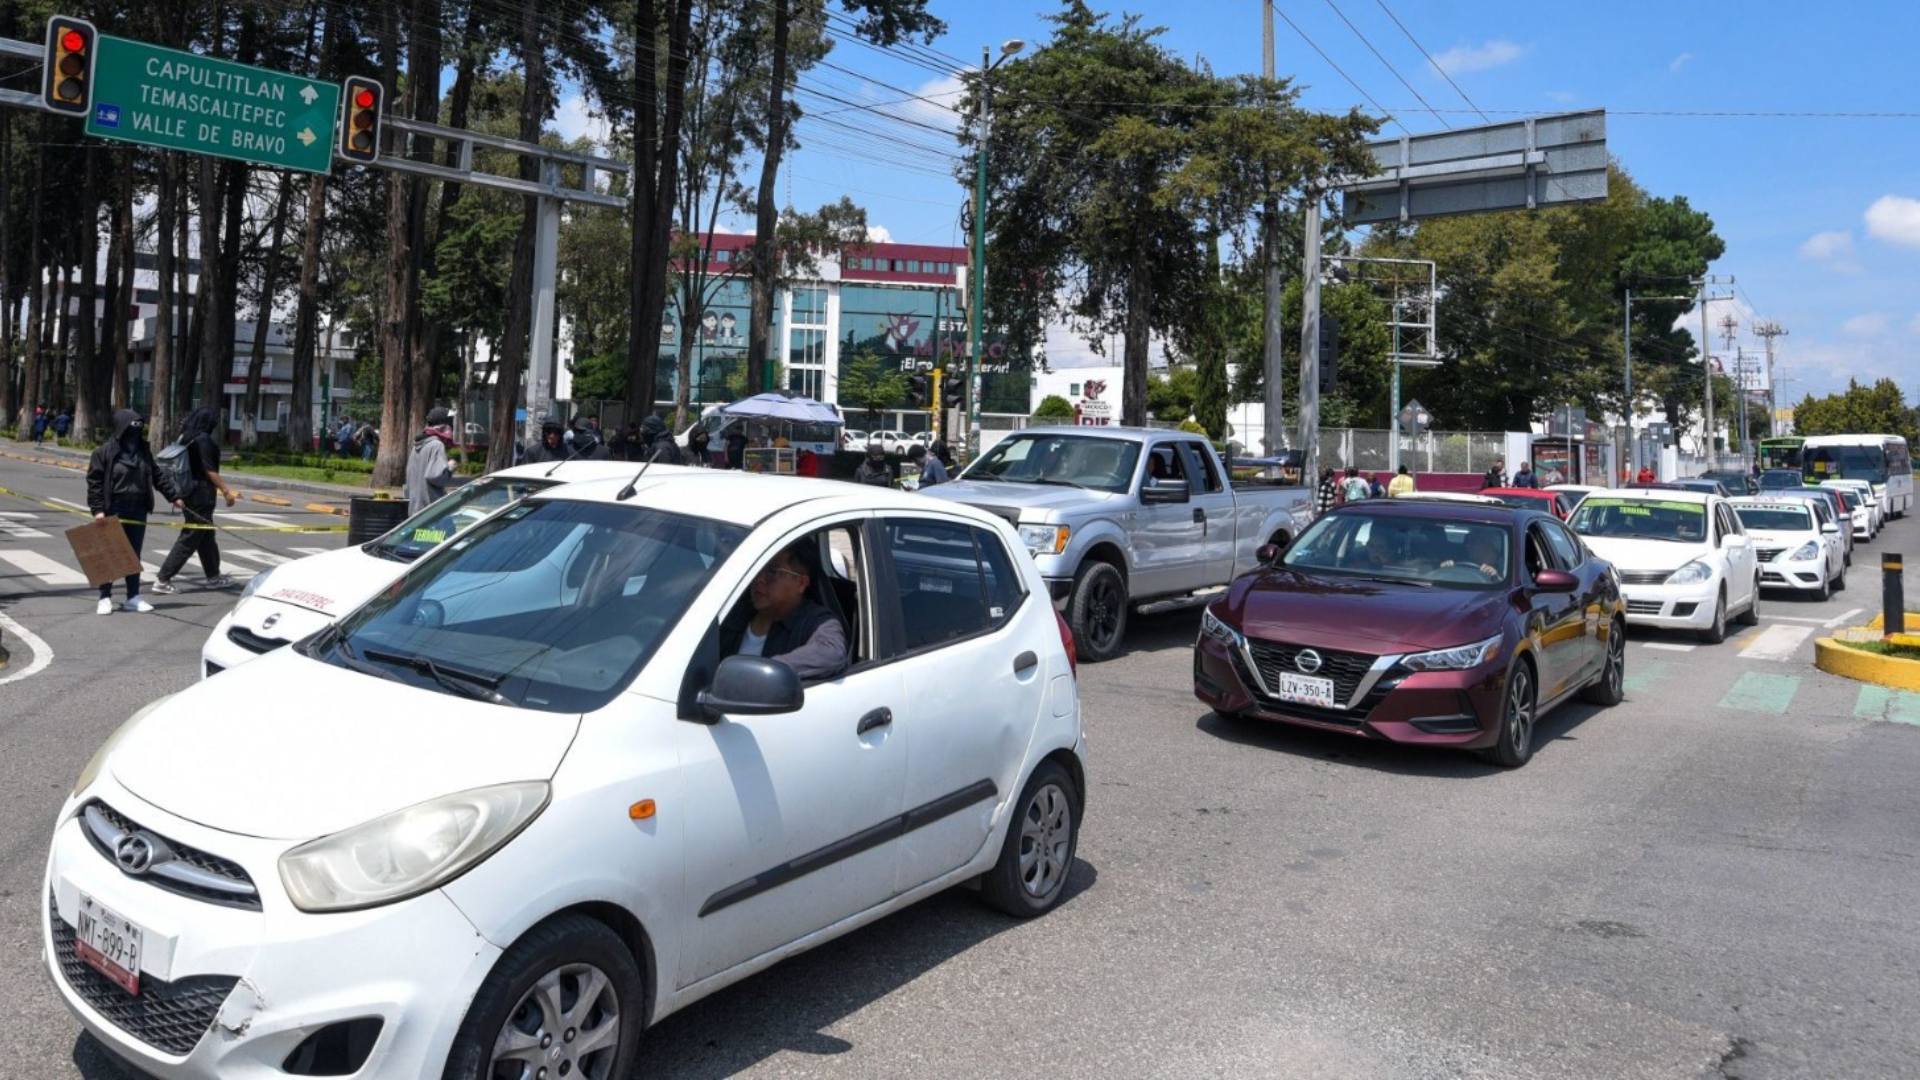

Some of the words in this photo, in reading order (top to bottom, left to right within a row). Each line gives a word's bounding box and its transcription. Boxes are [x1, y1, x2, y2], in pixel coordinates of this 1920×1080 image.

[146, 57, 284, 101] CAPULTITLAN
[141, 84, 286, 128] TEMASCALTEPEC
[132, 111, 187, 137] VALLE
[199, 124, 221, 144] DE
[232, 129, 285, 154] BRAVO
[939, 321, 989, 333] ESTAO
